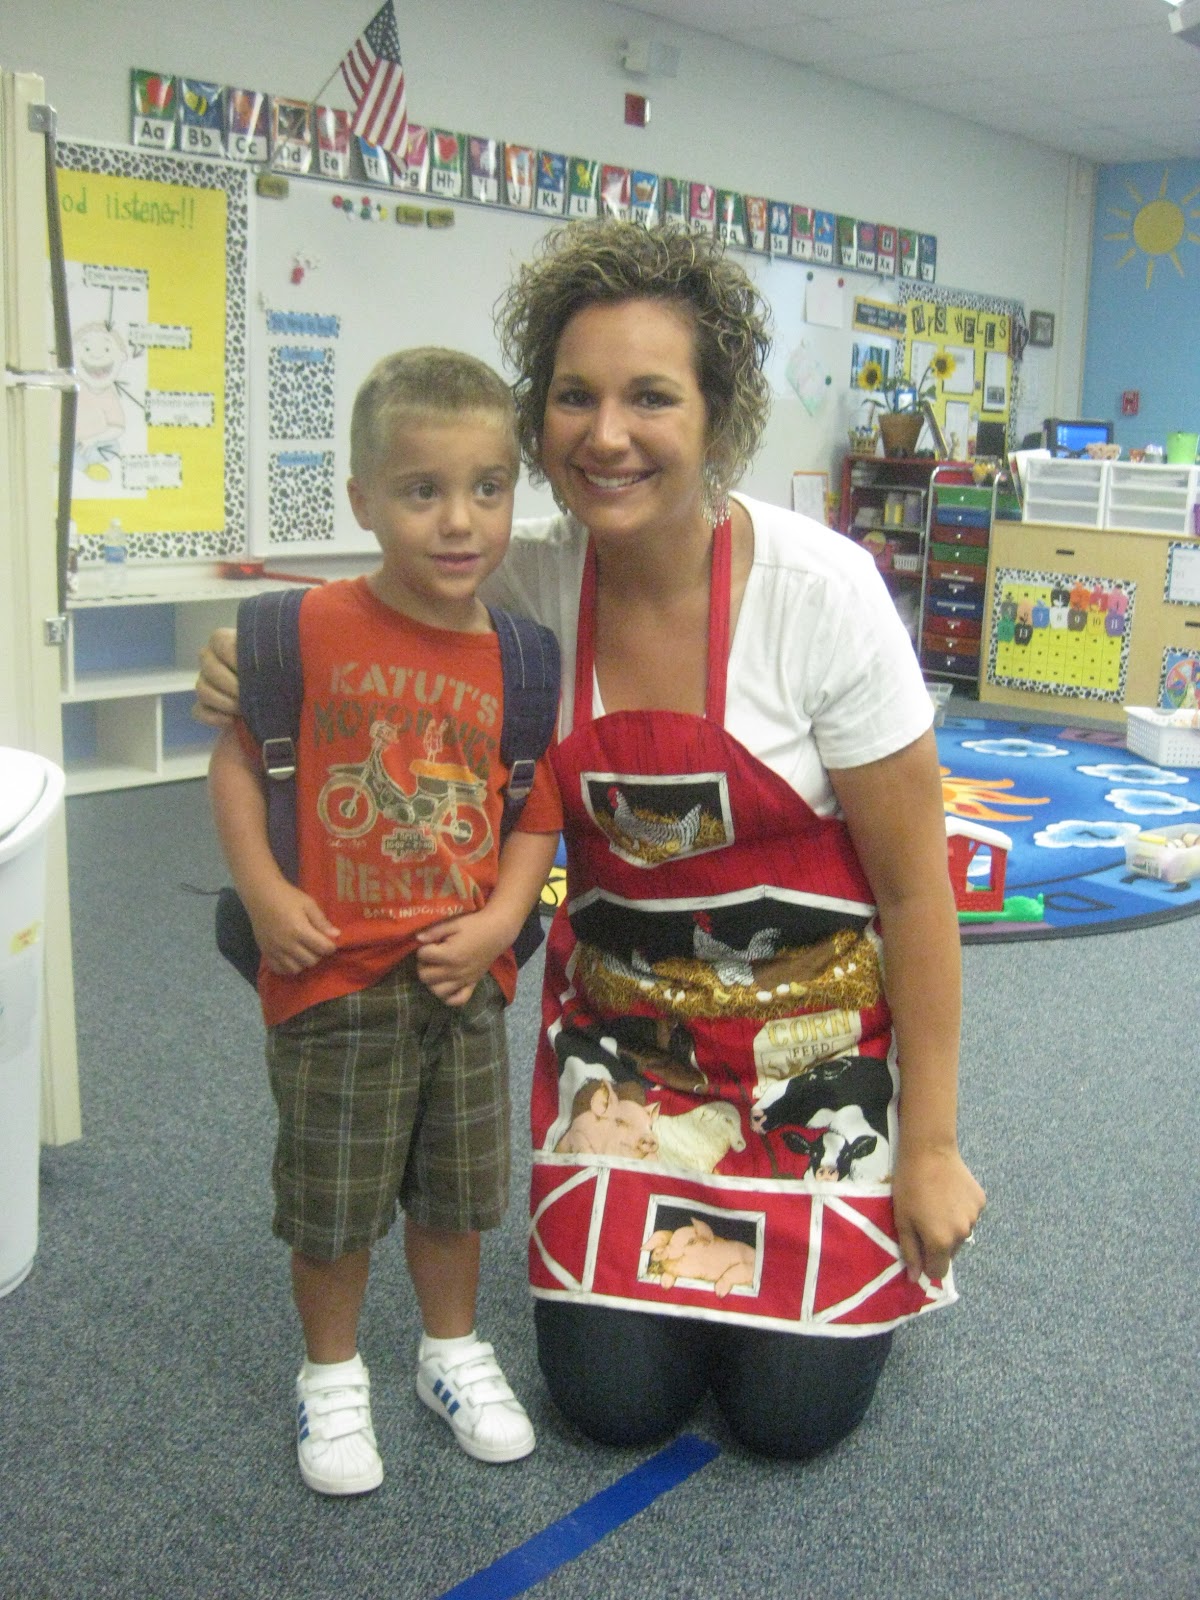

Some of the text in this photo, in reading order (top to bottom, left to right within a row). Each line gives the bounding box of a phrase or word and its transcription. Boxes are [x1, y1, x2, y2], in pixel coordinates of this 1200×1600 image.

[61, 186, 89, 214] od
[141, 120, 165, 140] Aa
[187, 128, 212, 148] Bb
[235, 136, 258, 154] Cc
[436, 171, 455, 188] Hh
[542, 192, 557, 208] Kk
[817, 244, 829, 257] Uu
[858, 253, 874, 266] Ww
[330, 661, 499, 728] KATUT'S
[335, 853, 484, 904] RENTA
[767, 1011, 852, 1048] CORN
[793, 1042, 830, 1059] FEED
